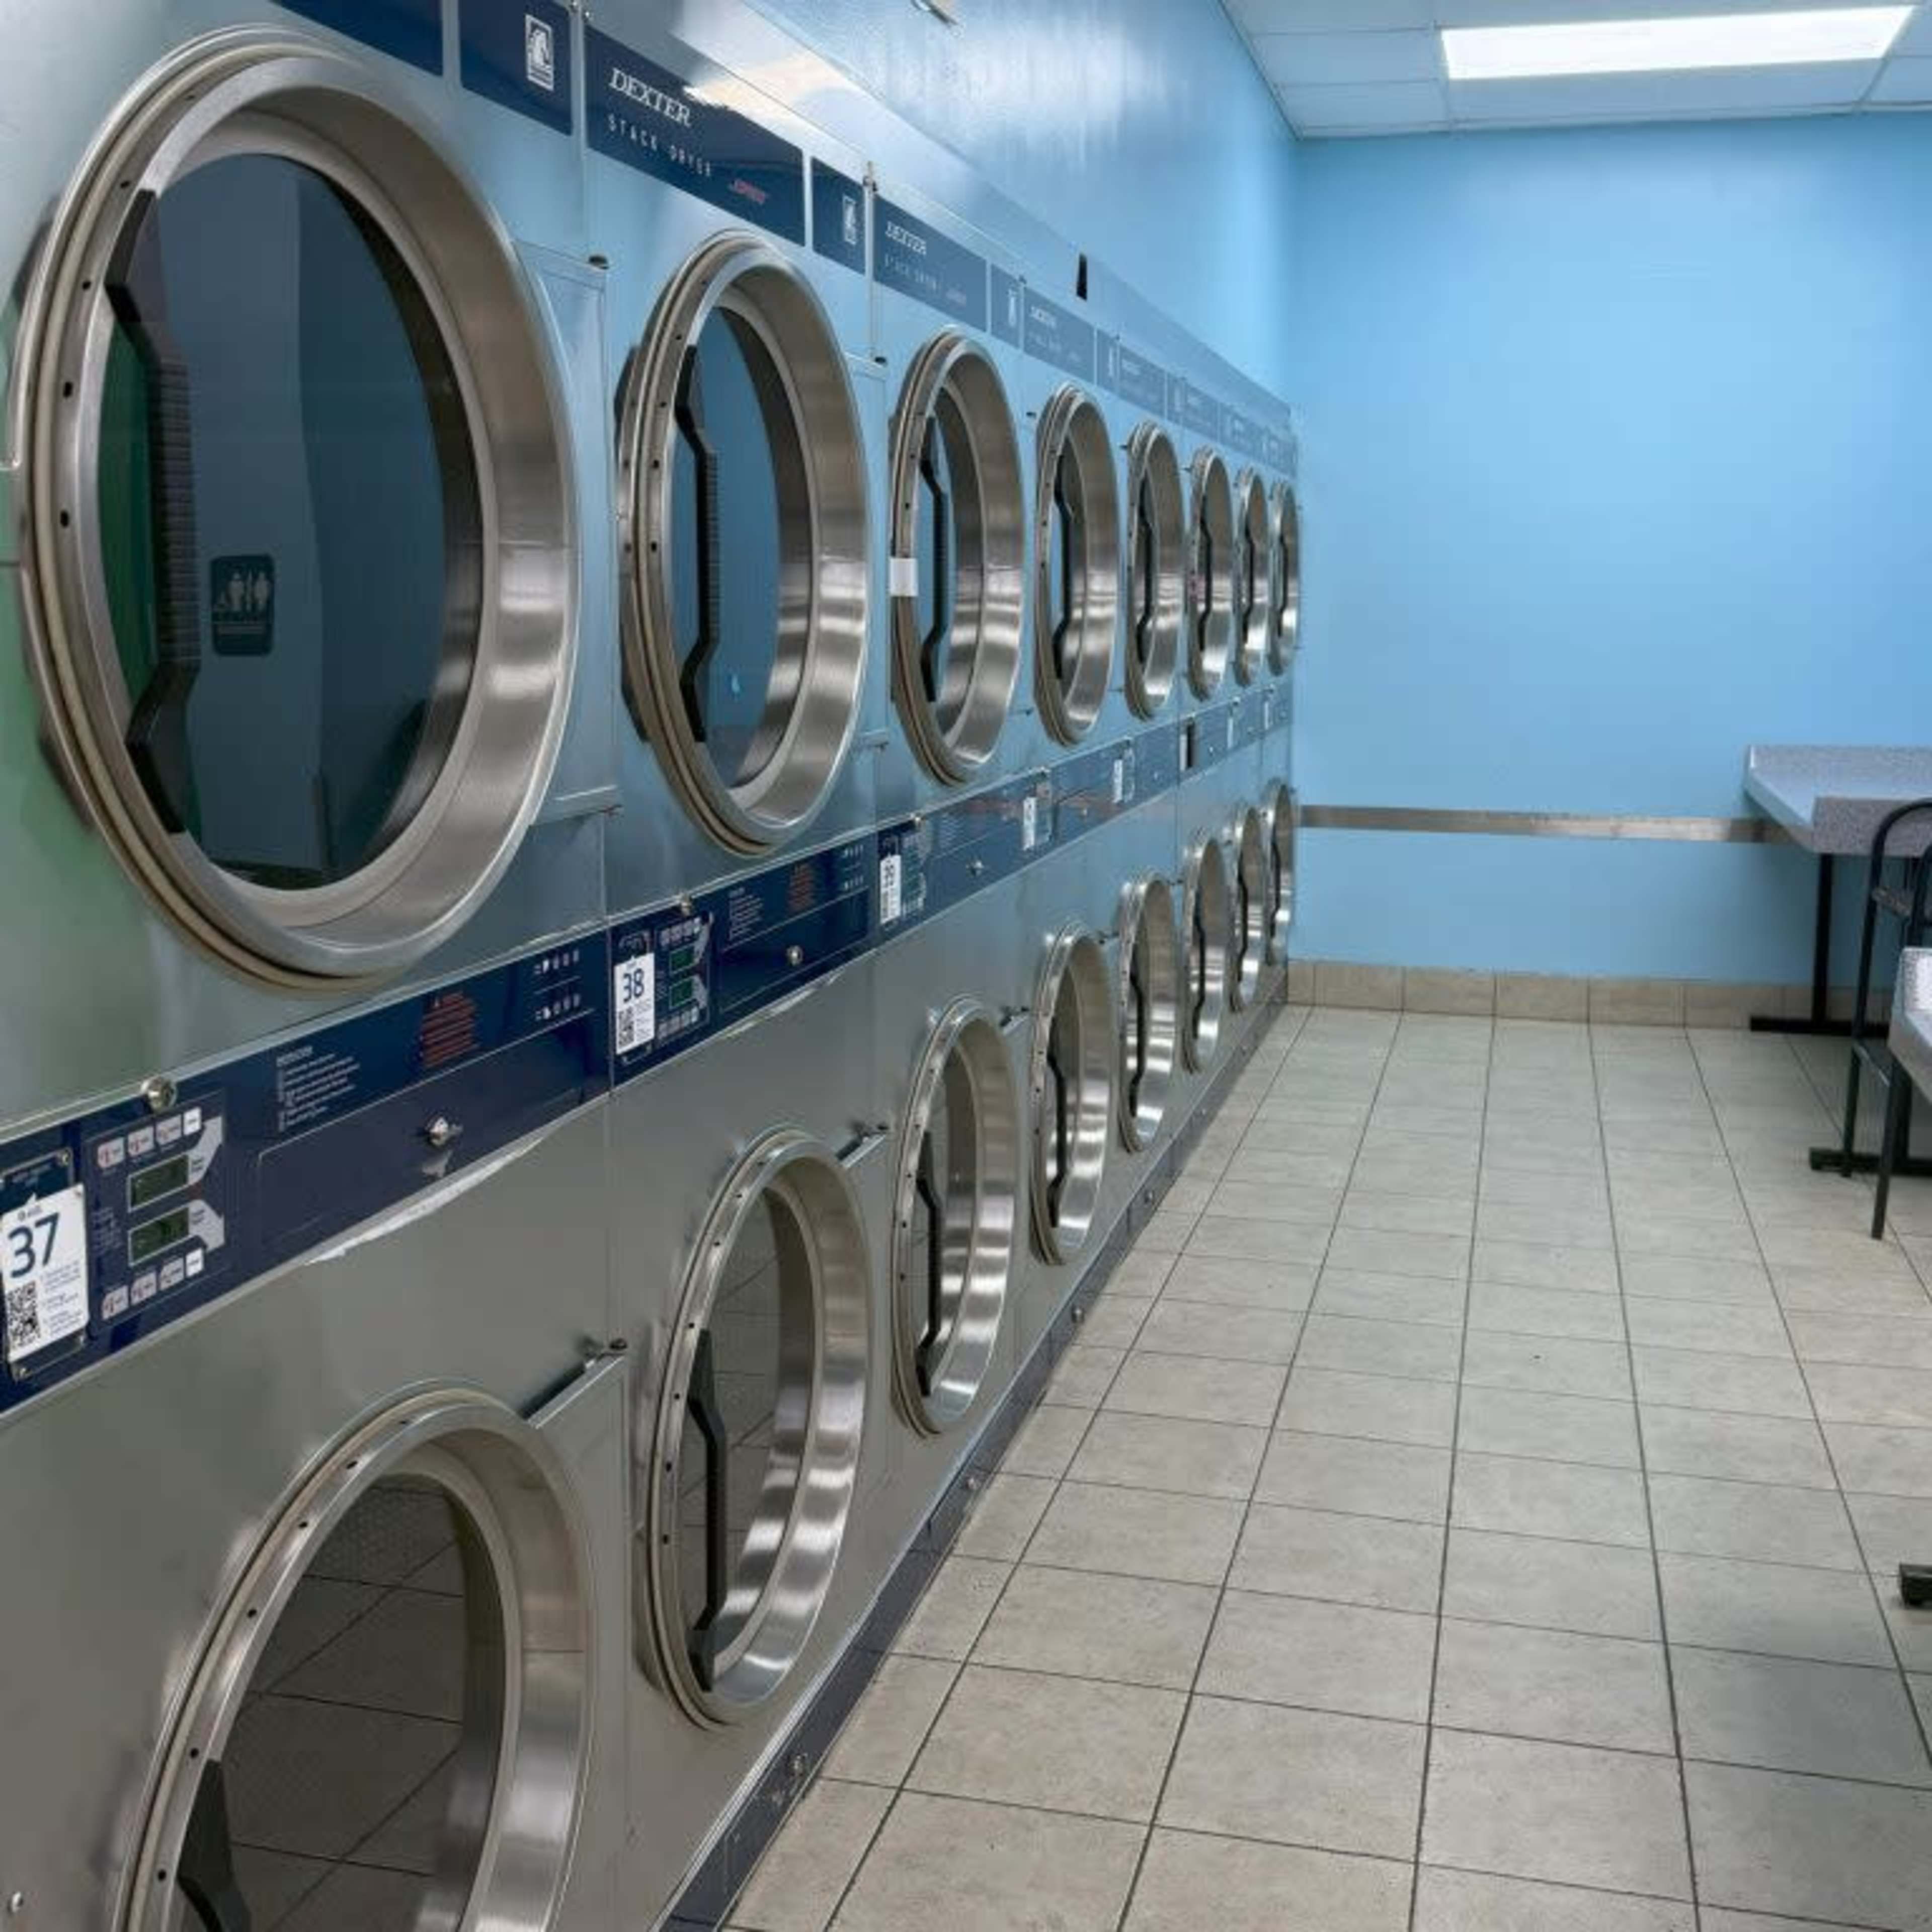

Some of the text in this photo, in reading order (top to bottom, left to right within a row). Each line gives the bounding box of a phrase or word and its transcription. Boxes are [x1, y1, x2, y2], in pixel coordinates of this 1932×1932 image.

[609, 67, 691, 127] DEXTER
[608, 113, 658, 151] STACK
[623, 968, 644, 1003] 38
[8, 1212, 60, 1278] 37
